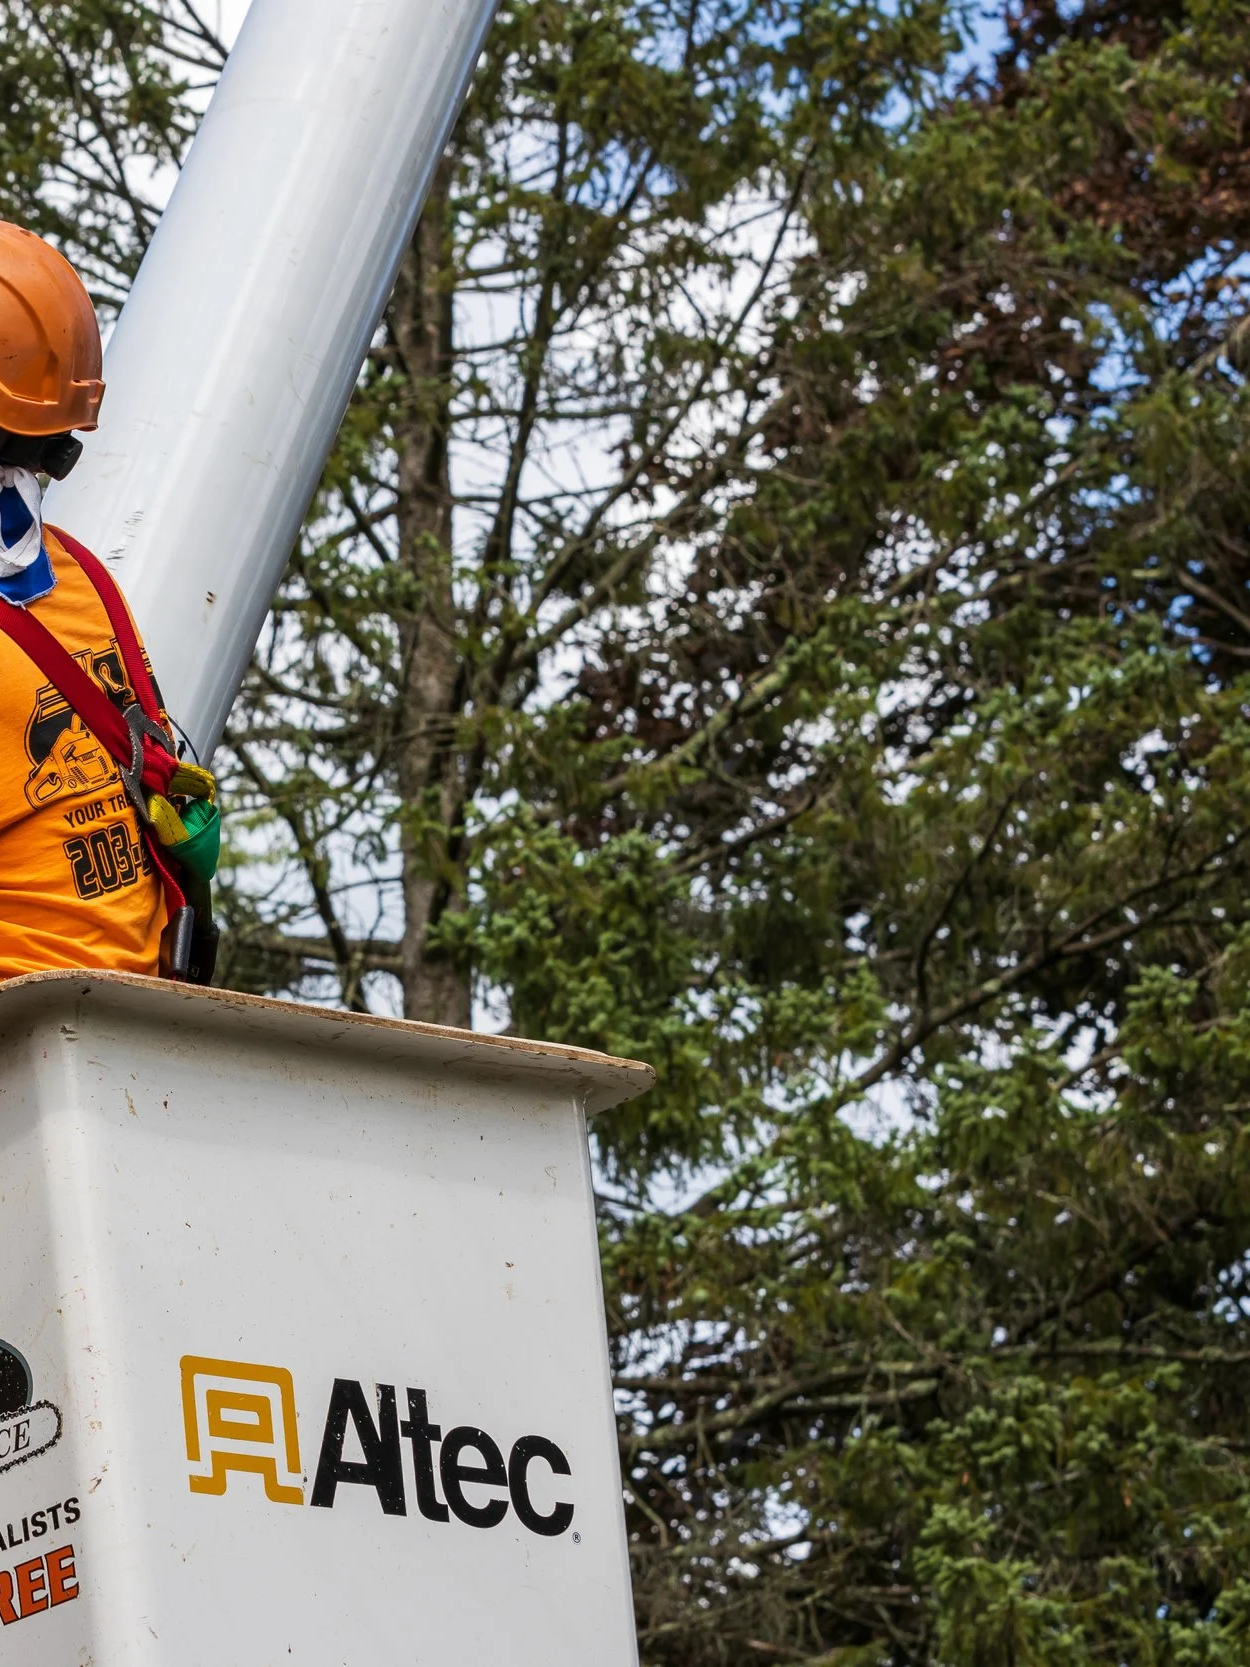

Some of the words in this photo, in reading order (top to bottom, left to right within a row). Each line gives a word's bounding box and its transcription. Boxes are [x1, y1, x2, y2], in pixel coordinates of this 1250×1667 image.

[63, 800, 106, 828] YOUR
[108, 793, 129, 812] TR
[62, 821, 152, 900] 203-
[310, 1377, 575, 1537] Altec
